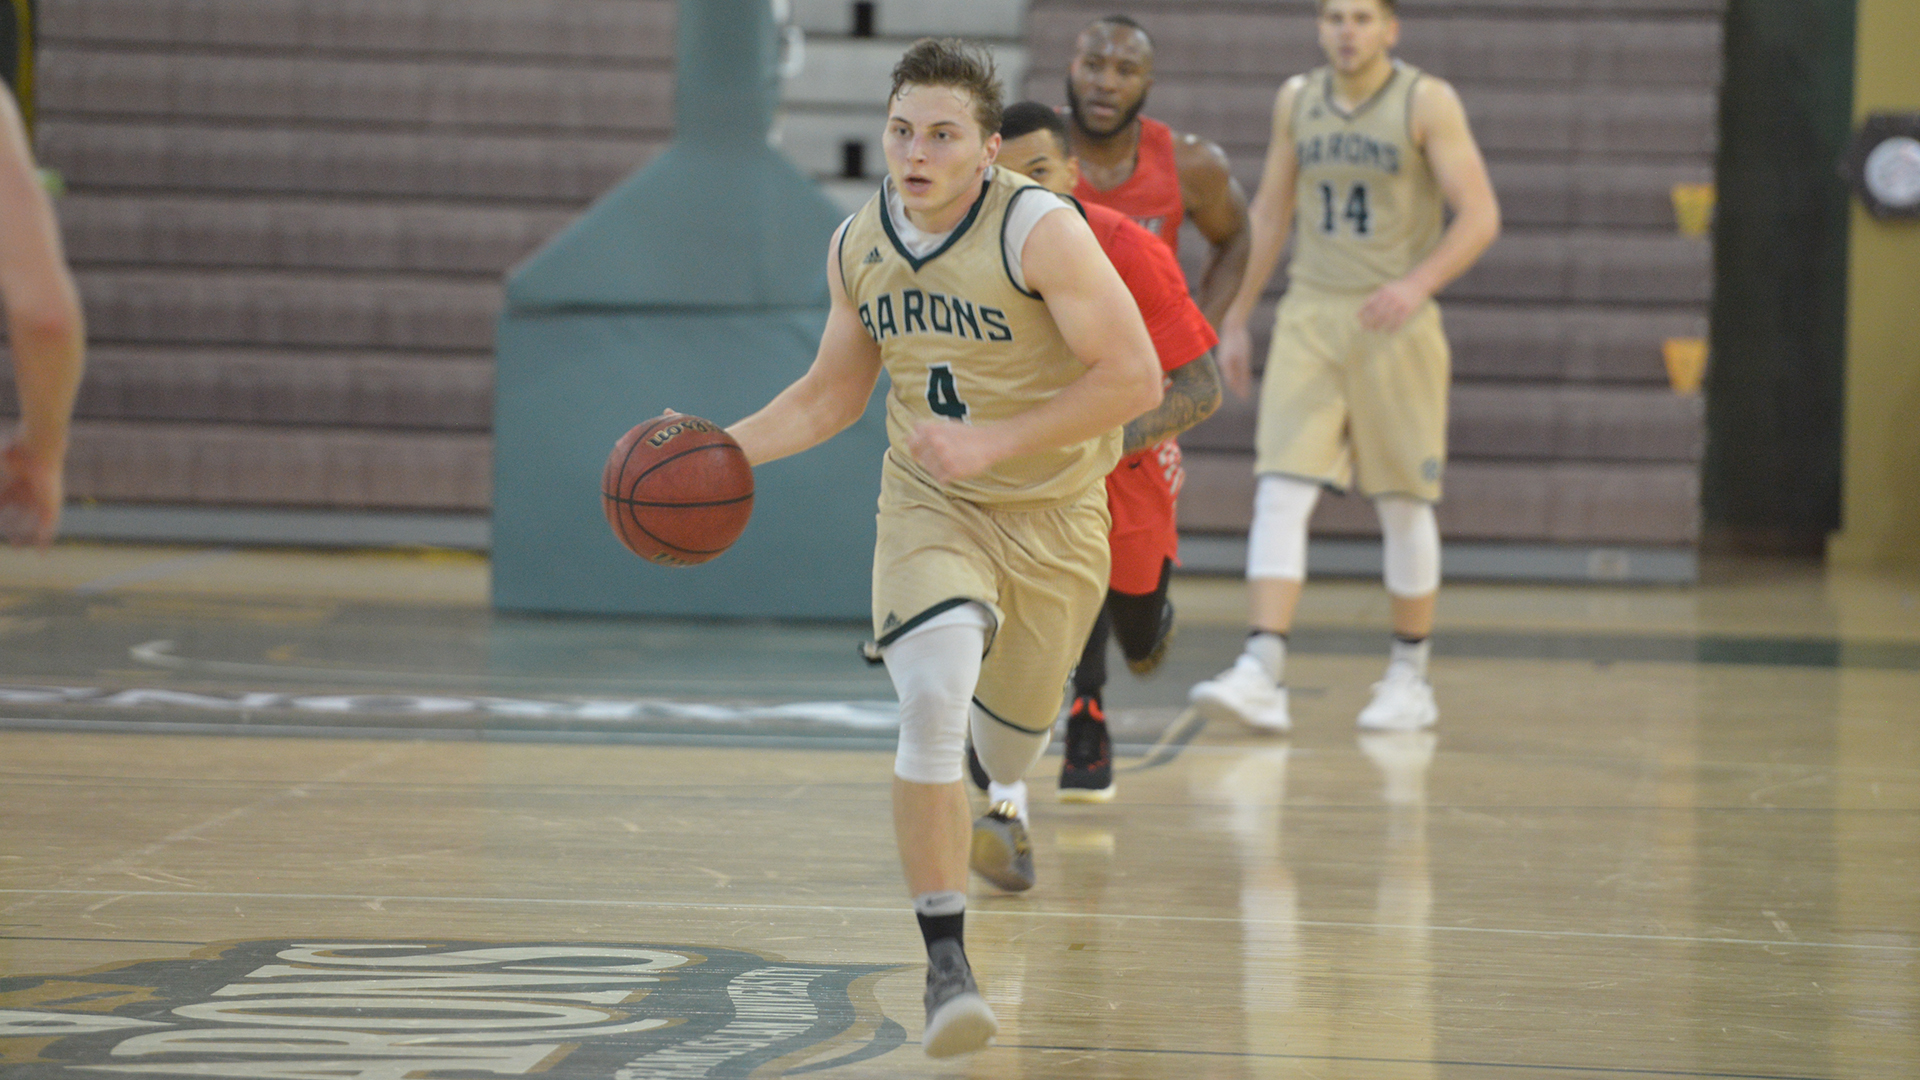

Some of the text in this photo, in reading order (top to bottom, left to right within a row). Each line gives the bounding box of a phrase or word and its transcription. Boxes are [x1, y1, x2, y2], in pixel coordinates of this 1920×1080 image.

[1321, 181, 1369, 234] 14
[925, 362, 972, 424] 4
[647, 420, 722, 449] lson
